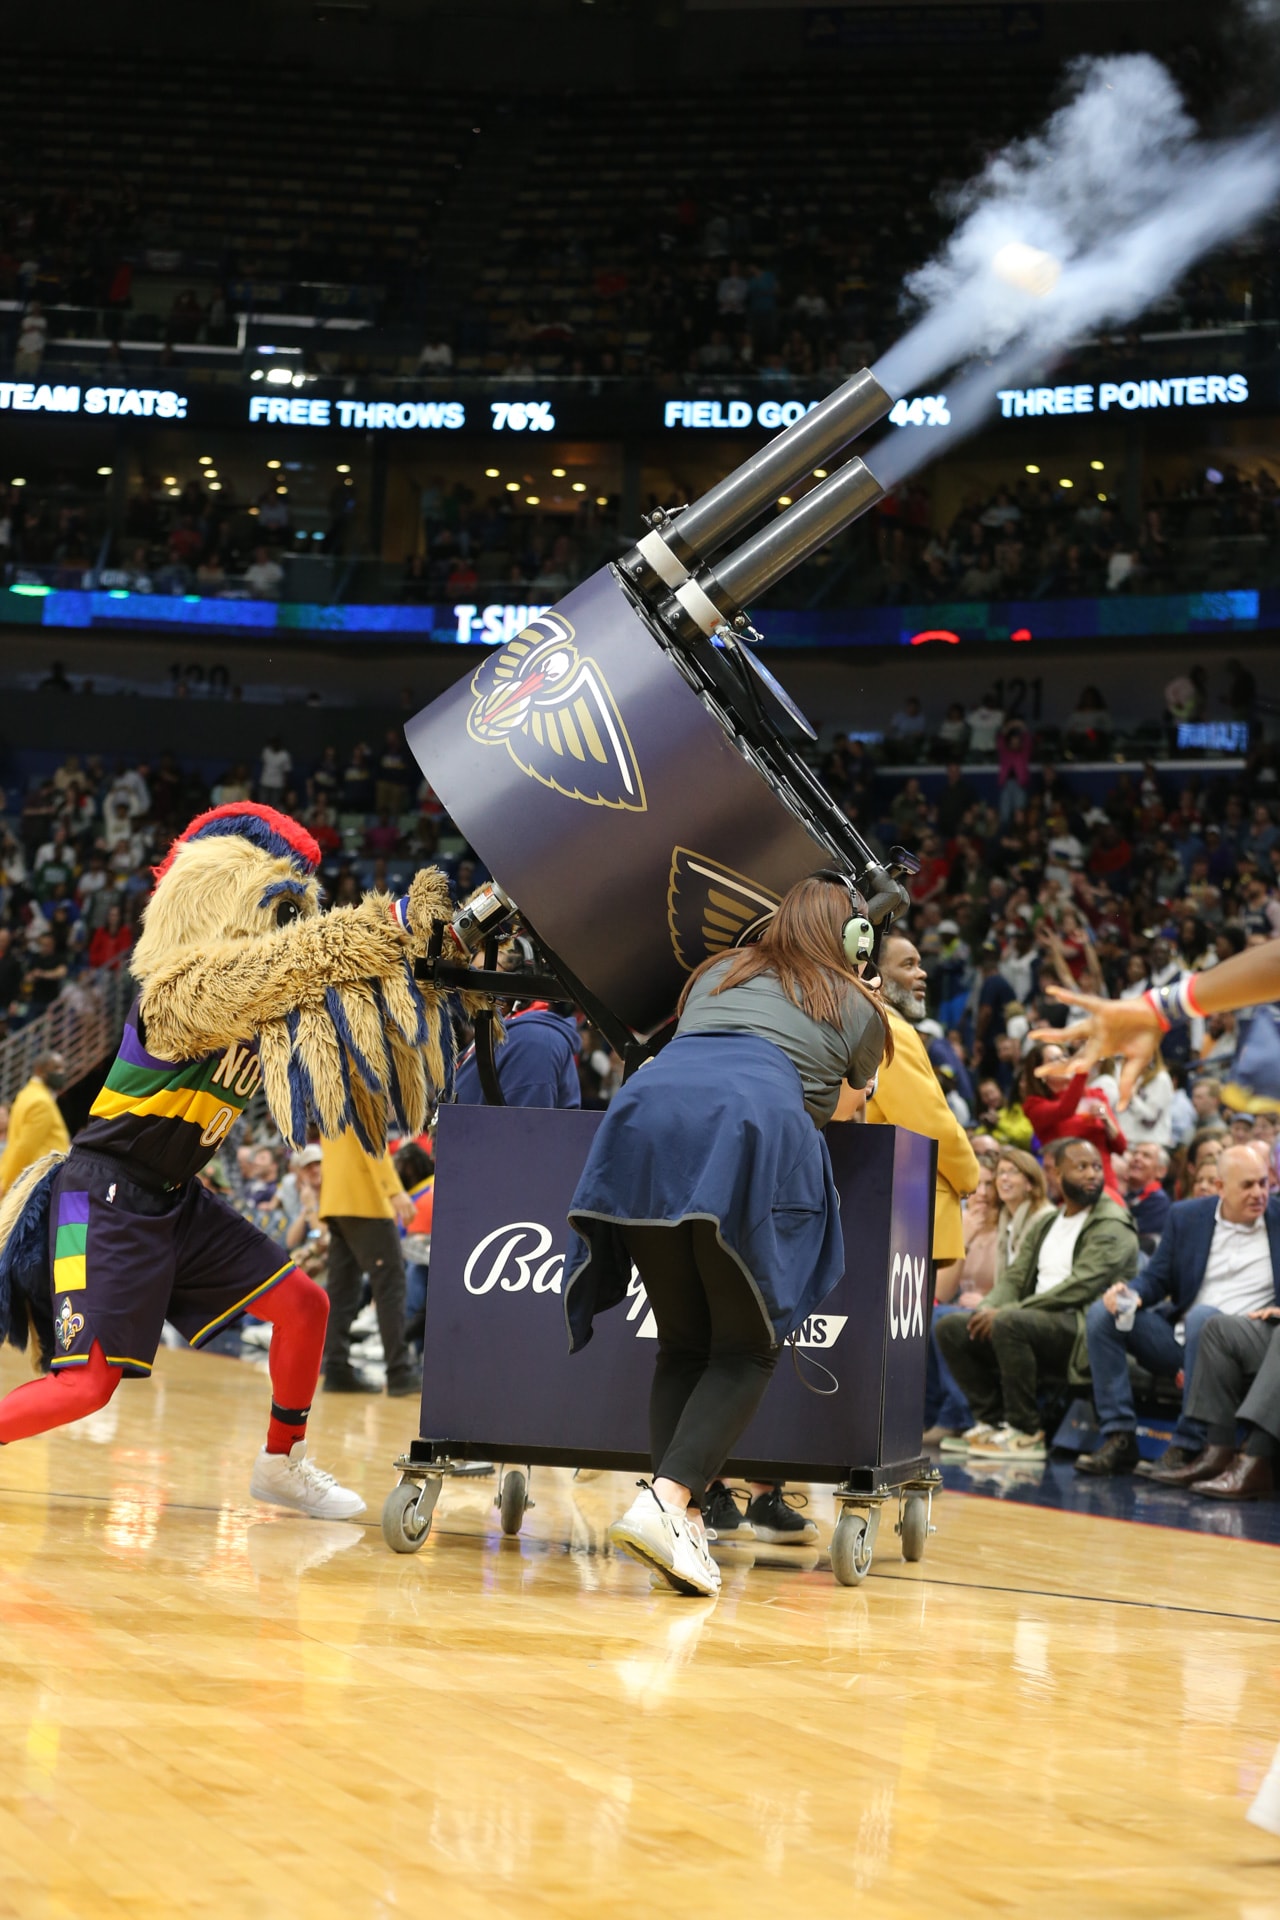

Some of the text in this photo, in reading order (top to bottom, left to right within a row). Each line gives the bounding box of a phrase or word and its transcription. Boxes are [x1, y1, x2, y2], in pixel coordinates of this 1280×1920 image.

[0, 382, 188, 418] TEAM STATS:
[249, 395, 555, 431] FREE THROWS 76%
[664, 395, 951, 428] FIELD GO 44%
[997, 373, 1248, 417] THREE POINTERS
[211, 1041, 263, 1099] NO
[890, 1252, 926, 1340] COX
